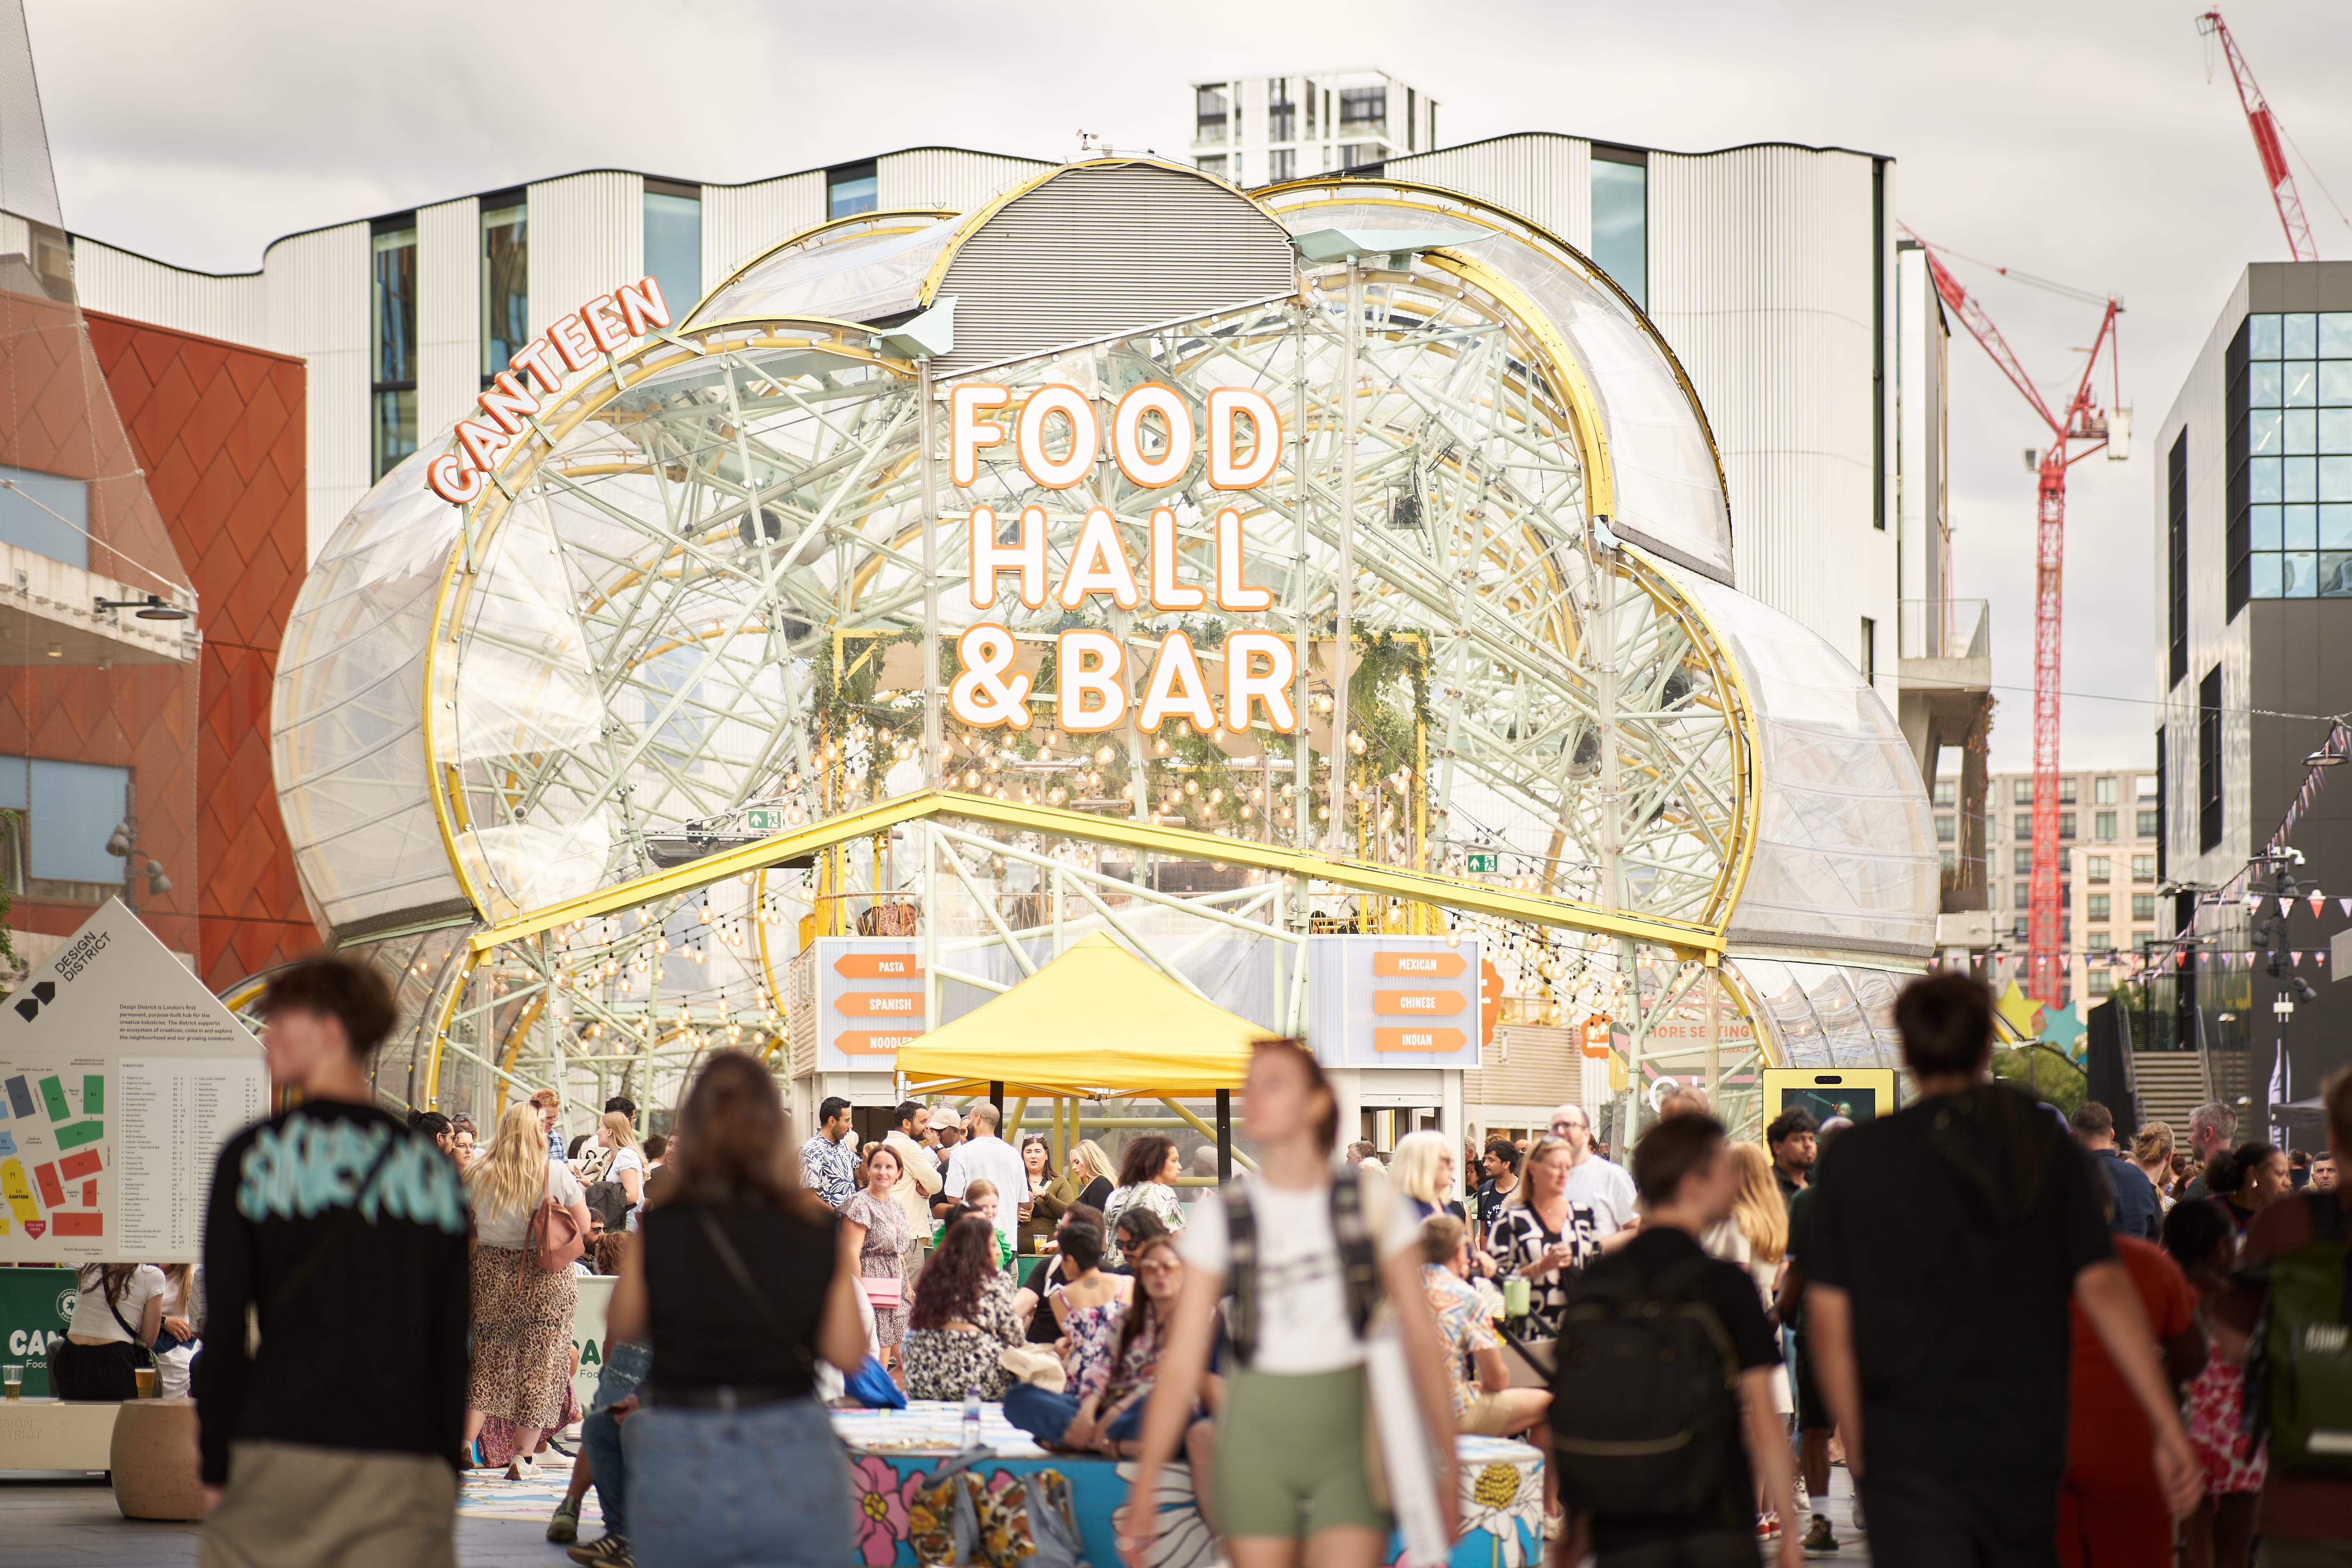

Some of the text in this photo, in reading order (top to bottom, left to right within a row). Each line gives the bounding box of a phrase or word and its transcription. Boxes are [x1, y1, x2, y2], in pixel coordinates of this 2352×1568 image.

[428, 275, 671, 503] CANTEEN
[950, 382, 1282, 490] FOOD
[969, 505, 1274, 612] HALL
[948, 622, 1298, 734] & BAR
[55, 931, 96, 973] DESIGN
[63, 931, 111, 981] DISTRICT
[1398, 958, 1437, 971] MEXICAN
[879, 962, 904, 972] PASTA
[869, 999, 912, 1010] SPANISH
[1400, 996, 1436, 1009] CHINESE
[1402, 1034, 1432, 1046] INDIAN
[1646, 1025, 1750, 1038] MORE SETING
